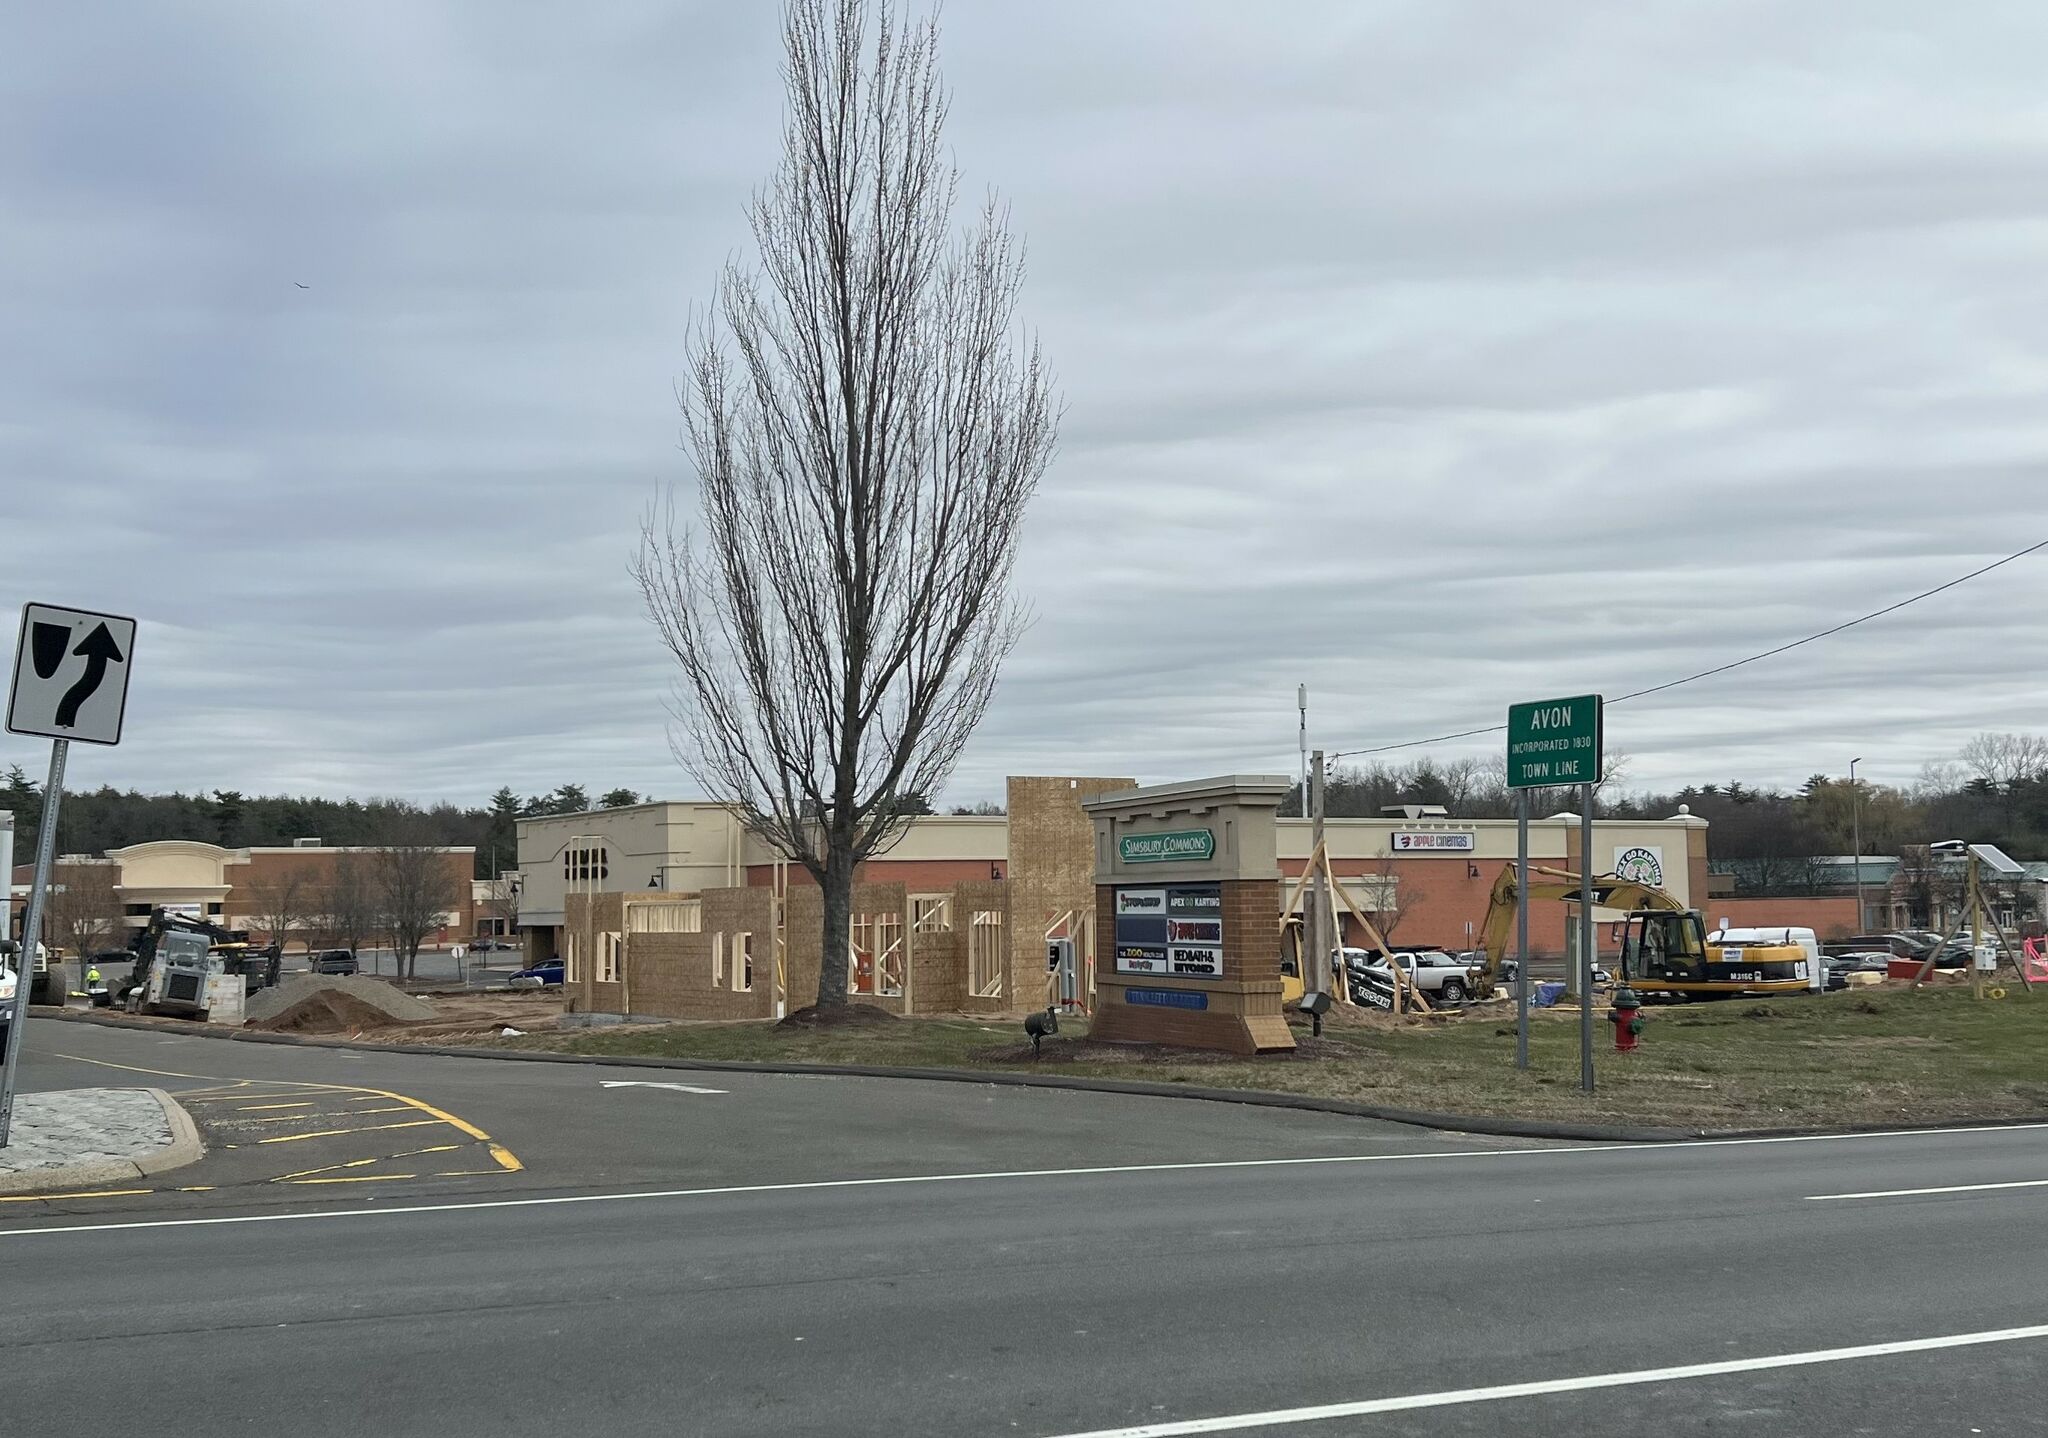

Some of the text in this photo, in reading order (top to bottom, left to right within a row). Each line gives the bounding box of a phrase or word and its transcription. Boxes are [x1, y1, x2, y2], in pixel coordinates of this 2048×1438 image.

[1531, 706, 1572, 730] AVON
[1512, 736, 1591, 754] INCORPORATED 1830
[1522, 760, 1579, 779] TOWN LINE
[1625, 850, 1637, 861] GO
[1637, 849, 1662, 884] KARTING
[1170, 897, 1185, 907] APEX
[1194, 897, 1220, 907] KARTING
[1126, 948, 1143, 957] ZOO
